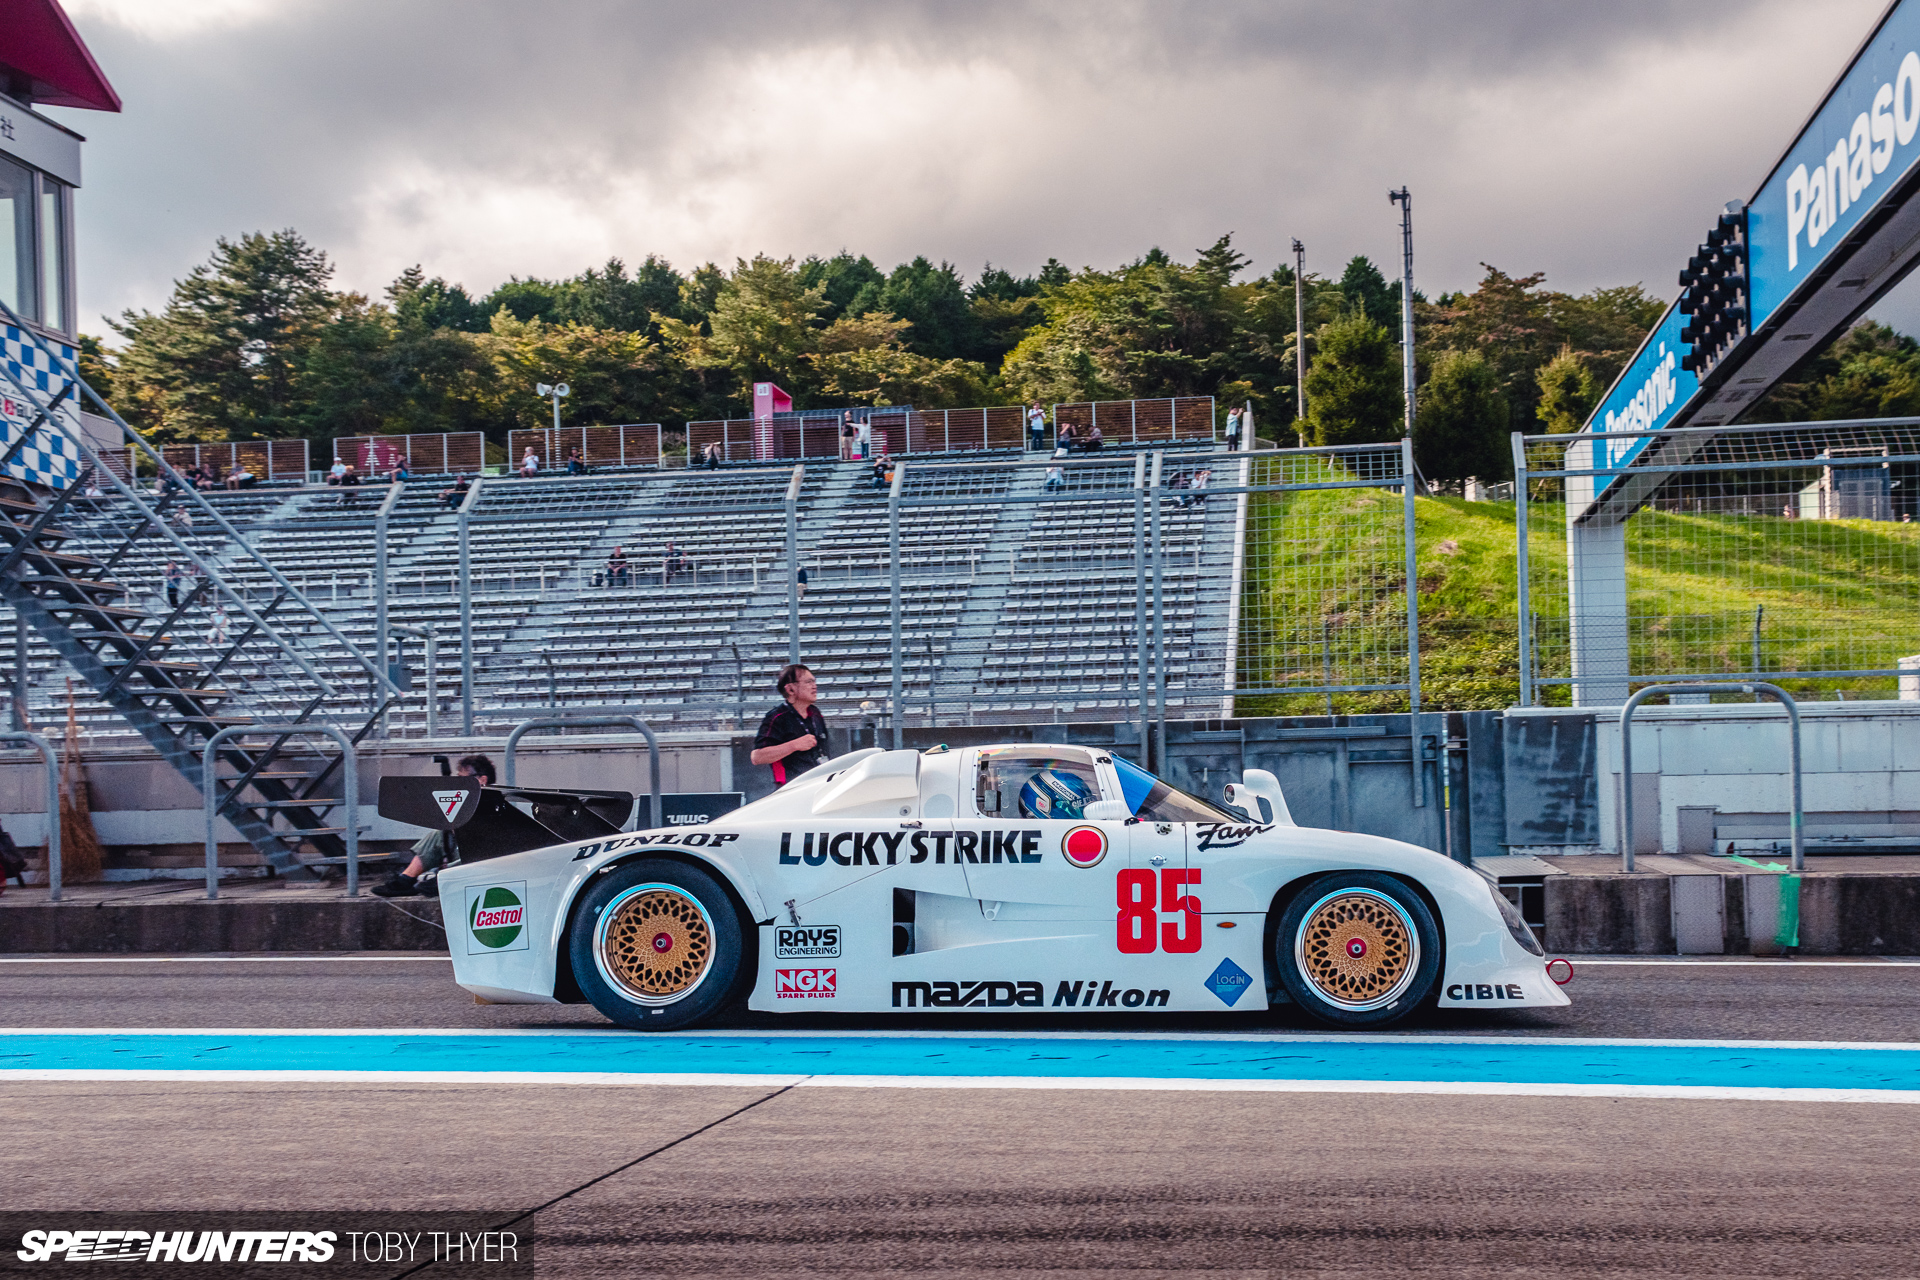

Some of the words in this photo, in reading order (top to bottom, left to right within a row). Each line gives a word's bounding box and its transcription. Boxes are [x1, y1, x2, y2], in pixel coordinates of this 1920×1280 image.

[1786, 51, 1920, 272] Panaso
[1605, 341, 1676, 469] Panasonic
[571, 833, 740, 862] DUNLOP
[779, 832, 907, 866] LUCKY
[910, 830, 1043, 864] STRIKE
[476, 907, 523, 927] Castrol
[1117, 869, 1202, 954] 85
[779, 929, 837, 947] RAYS
[780, 947, 837, 955] ENGINEERING
[777, 970, 835, 991] NGK
[892, 981, 1044, 1007] mazda
[1052, 981, 1171, 1007] Nikon
